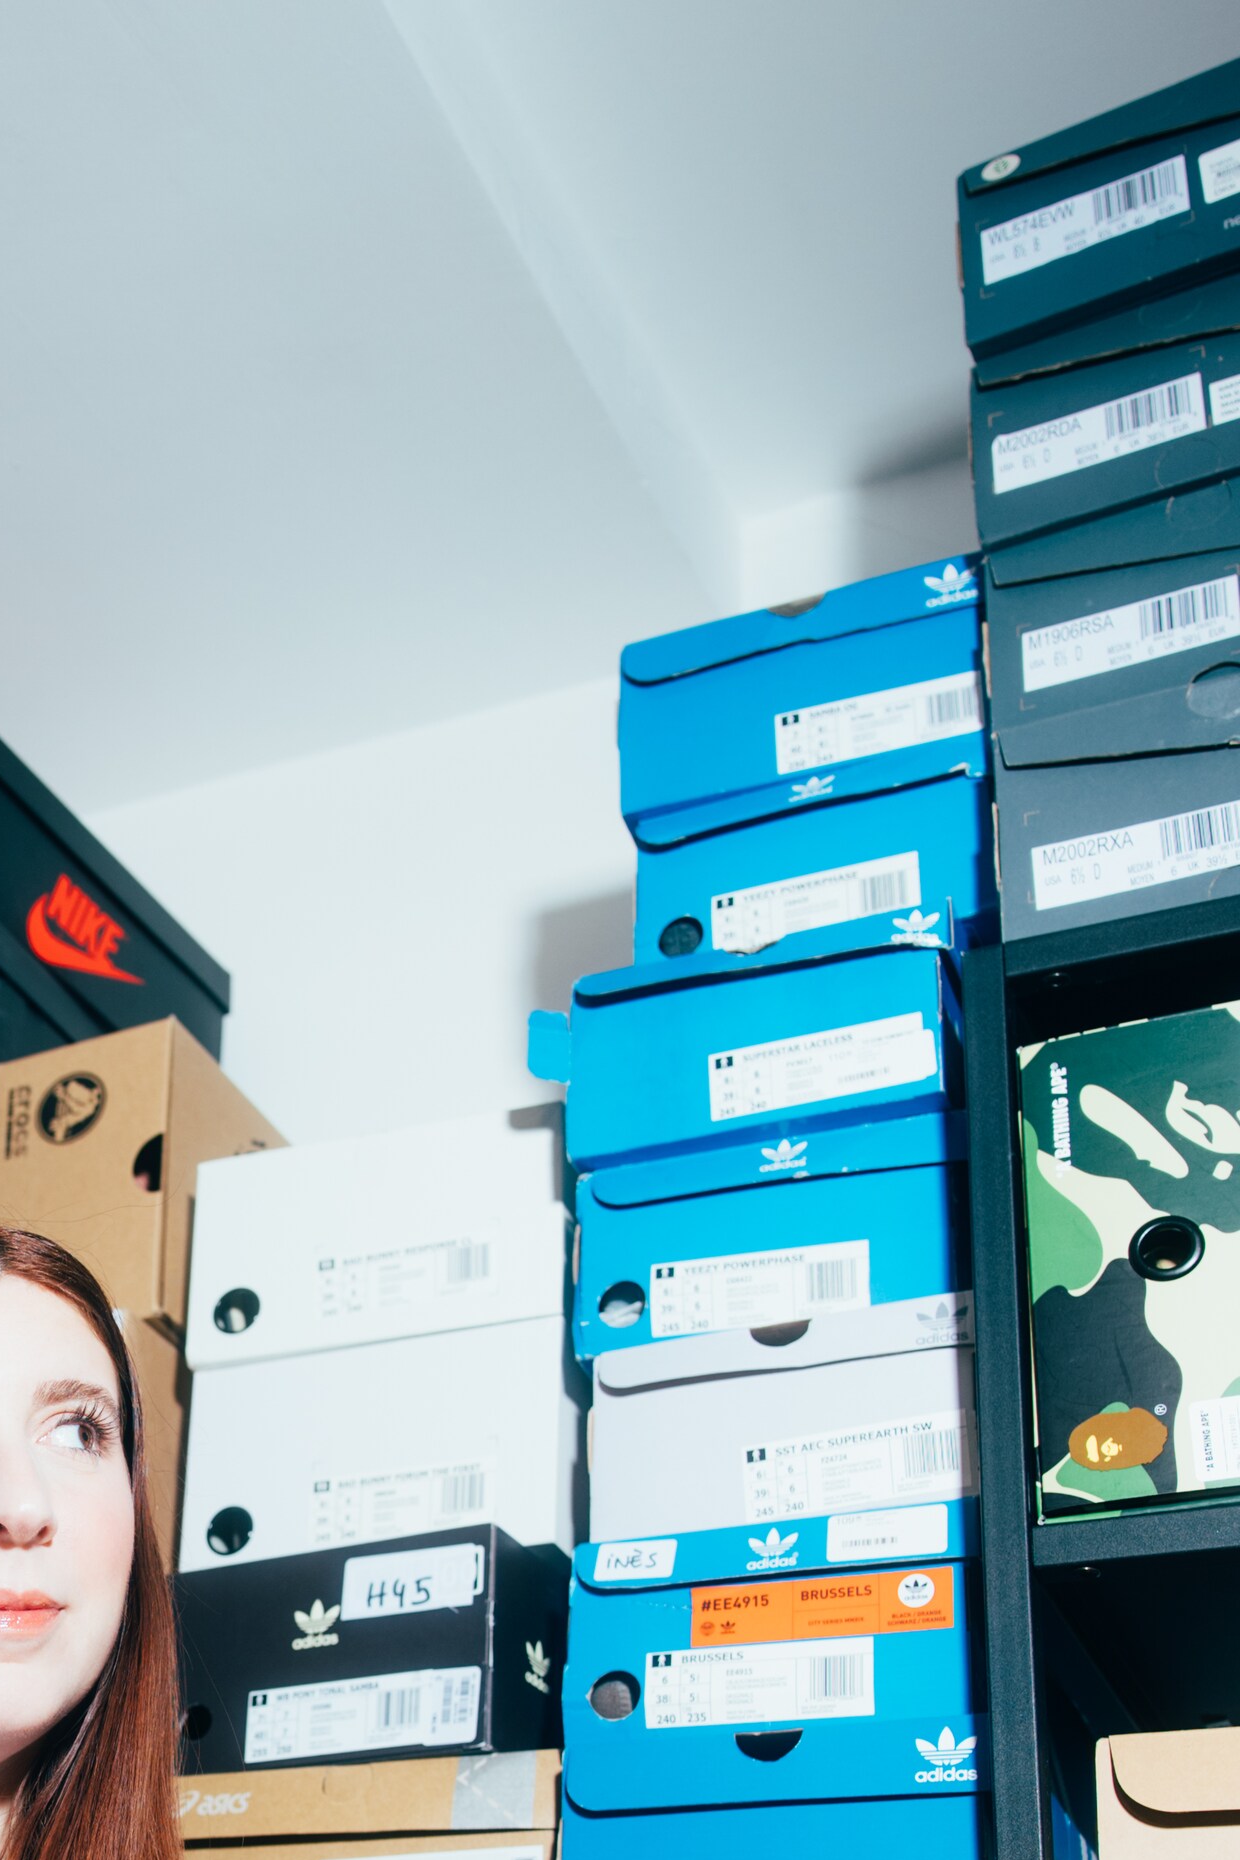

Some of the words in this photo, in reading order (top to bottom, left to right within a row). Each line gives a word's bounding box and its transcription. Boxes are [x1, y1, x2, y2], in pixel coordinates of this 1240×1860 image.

[998, 417, 1082, 455] M2002RDA
[1028, 615, 1114, 650] M1906RSA
[1043, 831, 1134, 866] M2002RXA
[44, 873, 129, 961] NIKE
[743, 1043, 801, 1063] SUPERSTAR
[804, 1033, 854, 1052] LACELESS
[1052, 1097, 1071, 1158] BATHING
[684, 1265, 719, 1276] YEEZY
[723, 1254, 806, 1271] POWERPHASE
[915, 1329, 970, 1346] adidas
[775, 1446, 796, 1457] SST
[801, 1440, 824, 1452] AEC
[827, 1426, 909, 1448] SUPEREARTH
[912, 1421, 933, 1433] SW
[755, 1506, 775, 1519] 245
[785, 1501, 804, 1513] 240
[746, 1554, 796, 1572] adidas
[800, 1585, 872, 1602] BRUSSELS
[701, 1594, 769, 1612] #EE4915
[681, 1651, 744, 1665] BRUSSELS
[662, 1675, 669, 1685] 6
[656, 1713, 676, 1725] 240
[687, 1711, 707, 1723] 235
[914, 1766, 978, 1783] adidas
[197, 1791, 252, 1816] asics
